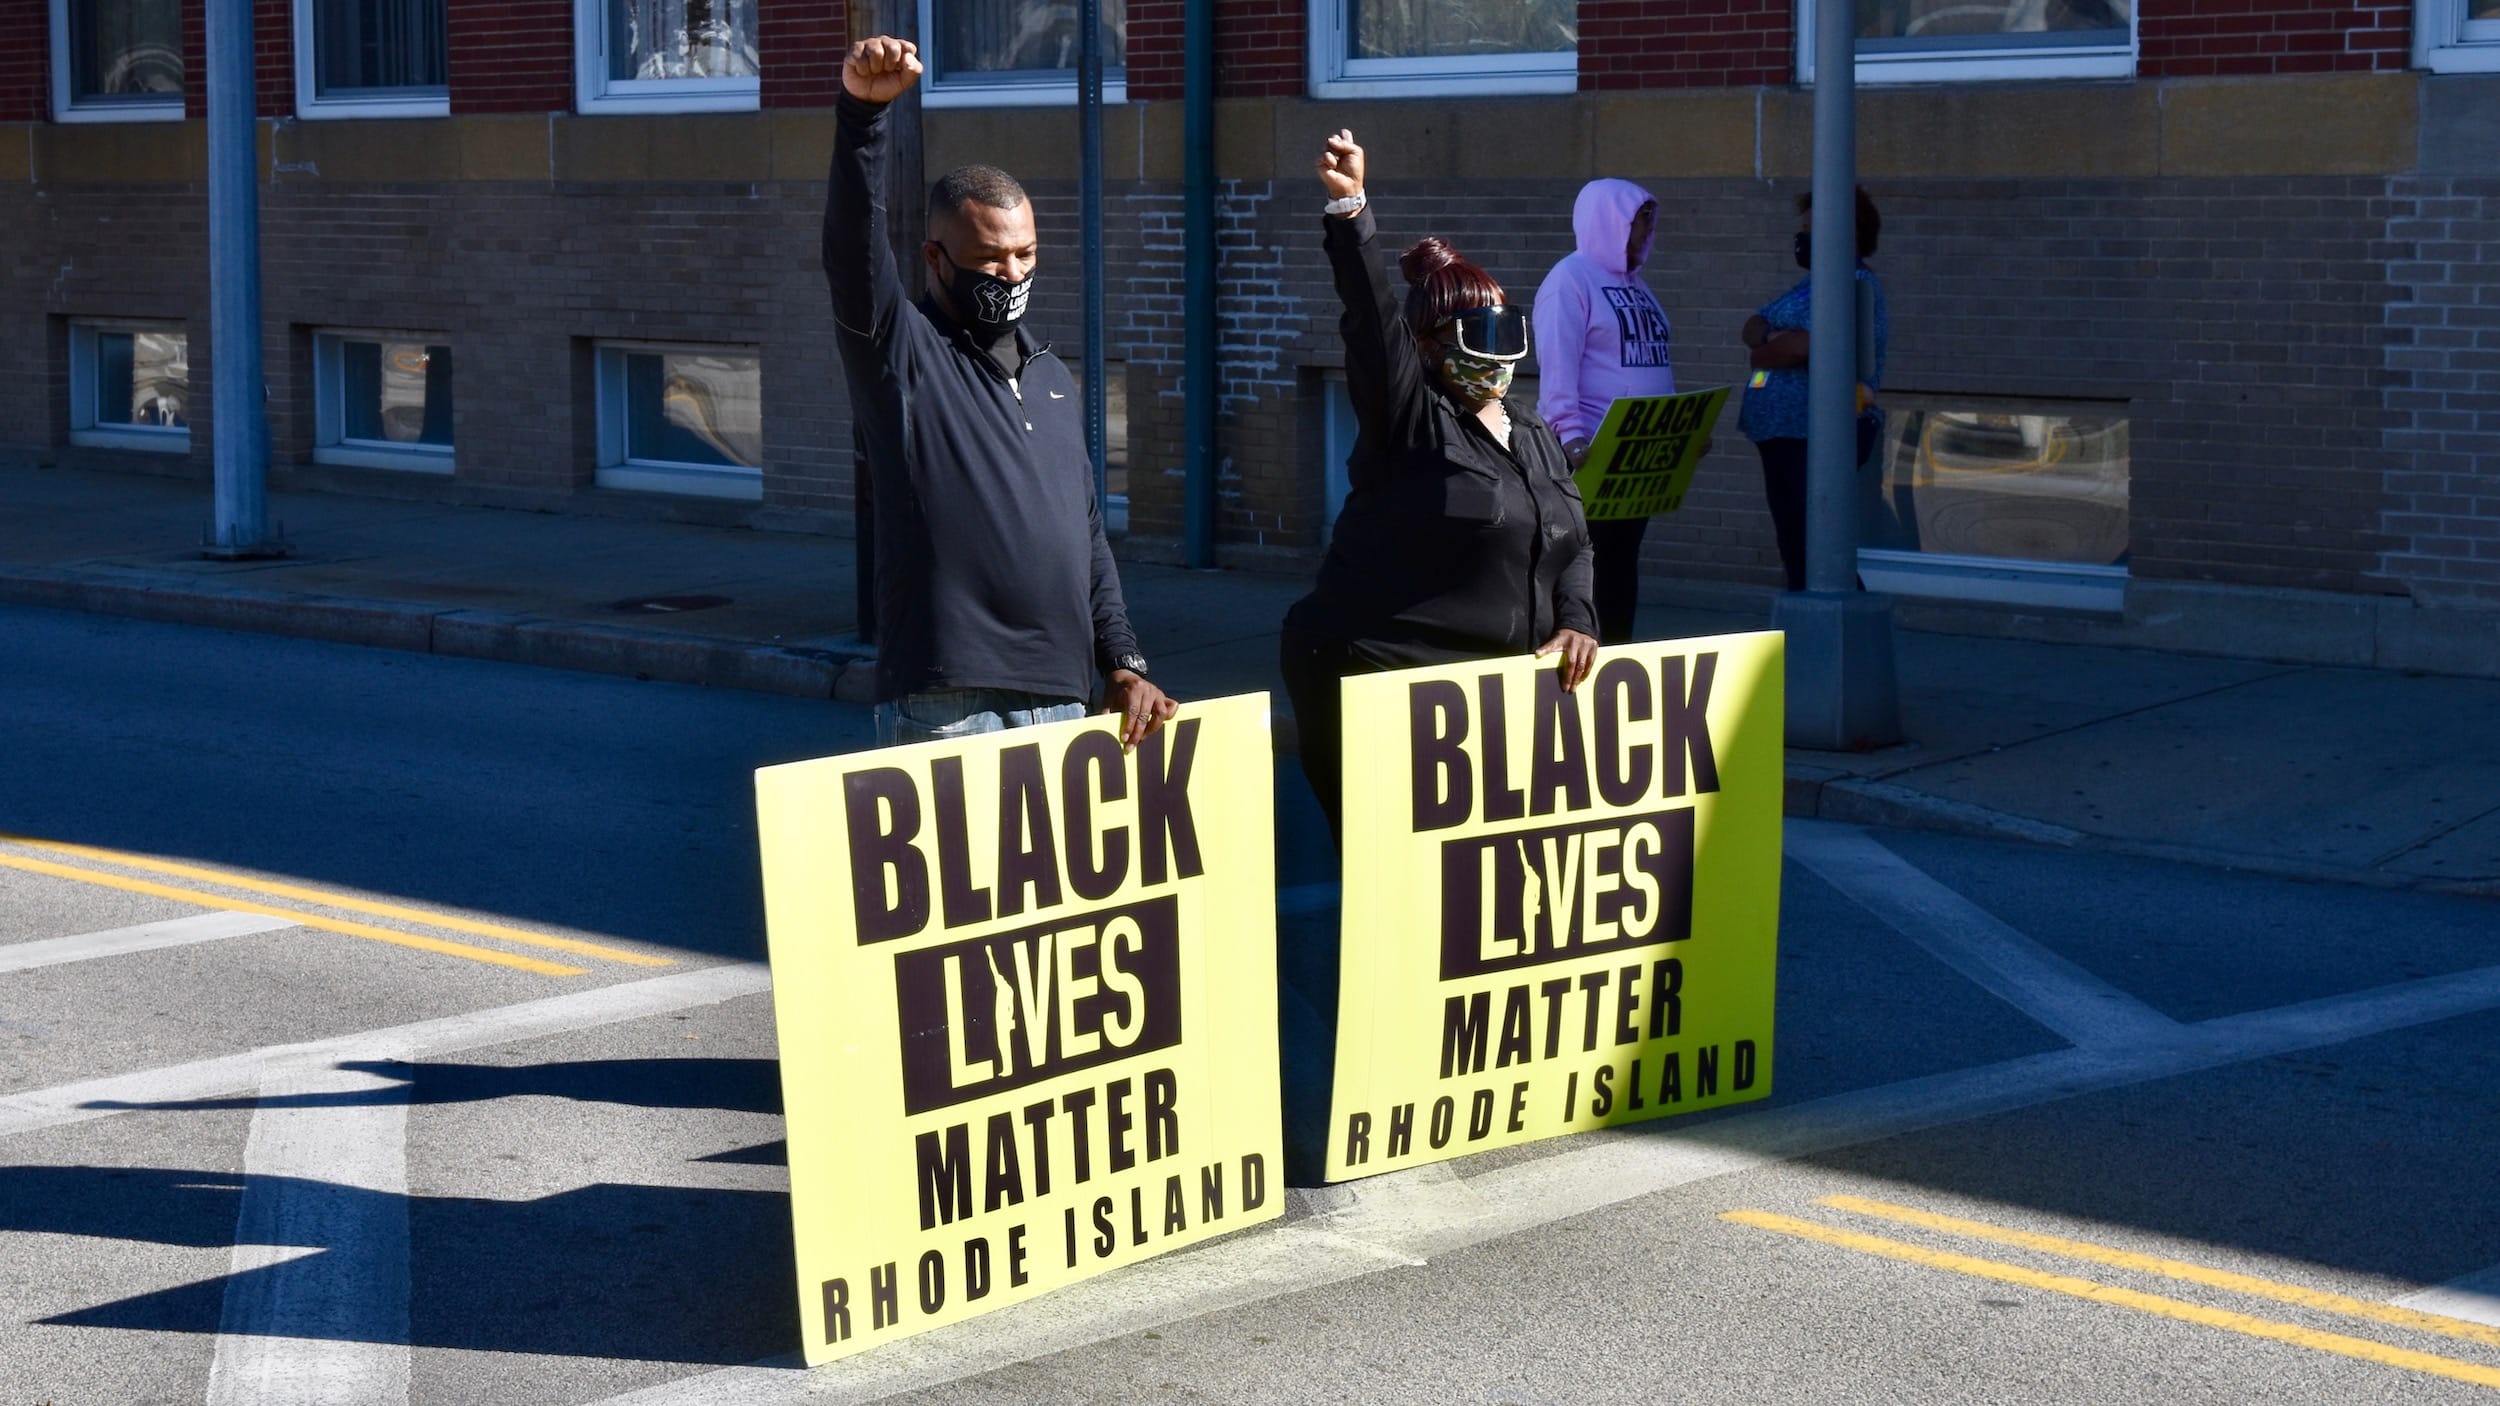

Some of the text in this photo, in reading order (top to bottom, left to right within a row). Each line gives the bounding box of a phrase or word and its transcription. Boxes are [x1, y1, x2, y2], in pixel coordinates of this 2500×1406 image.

[1615, 393, 1714, 437] BLACK
[1625, 341, 1669, 365] MATTE
[1595, 474, 1672, 499] MATTER
[1618, 437, 1680, 472] LIVES
[1408, 651, 1720, 833] BLACK
[842, 717, 1205, 946] BLACK
[1480, 822, 1662, 963] LIVES
[943, 915, 1145, 1089] LIVES
[1439, 957, 1684, 1080] MATTER
[915, 1067, 1180, 1232] MATTER
[1345, 1039, 1756, 1168] RHODE ISLAND
[821, 1152, 1266, 1345] RHODE ISLAND
